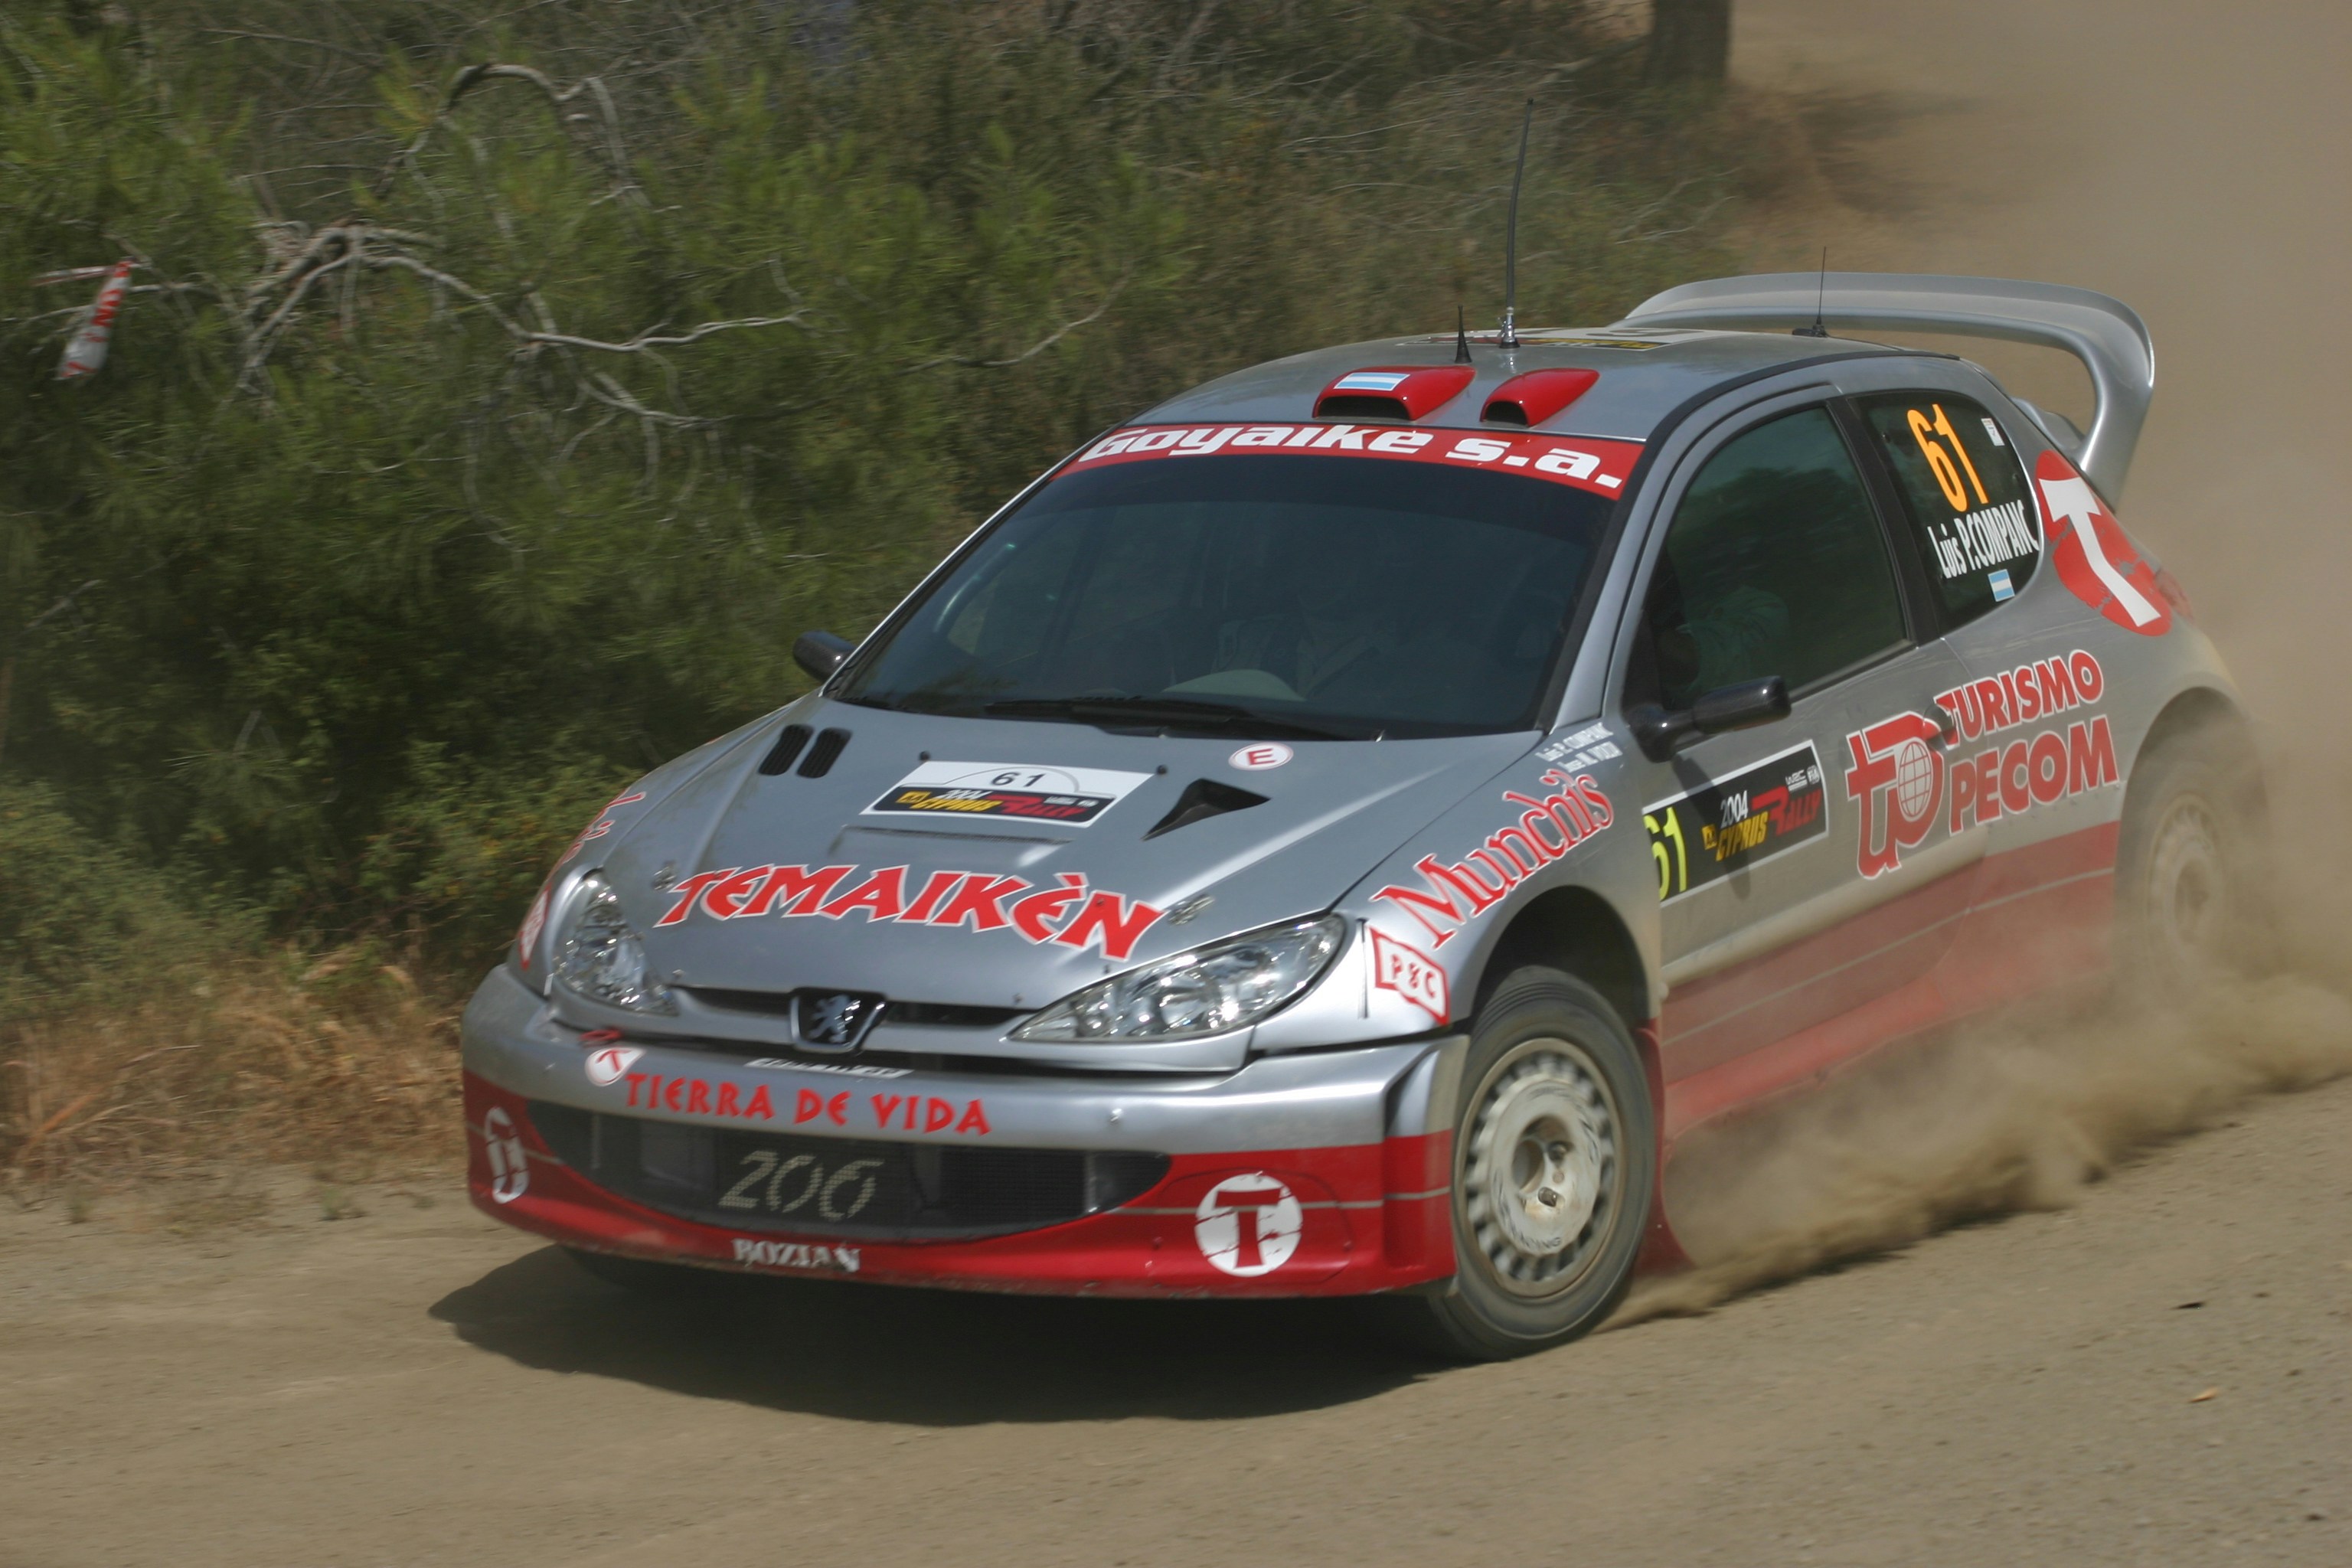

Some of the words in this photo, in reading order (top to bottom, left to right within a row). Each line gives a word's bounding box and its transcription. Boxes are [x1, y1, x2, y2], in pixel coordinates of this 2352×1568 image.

[1079, 425, 1433, 463] Goyaike
[1446, 436, 1622, 488] s.a.
[1907, 403, 1989, 512] 61
[1927, 524, 1968, 580] Luis
[1954, 499, 2040, 571] P.COMPANC
[1933, 648, 2104, 751] TURISMO
[991, 772, 1047, 788] 61
[1246, 748, 1277, 766] E
[1949, 714, 2119, 838] PECOM
[1715, 811, 1769, 861] CYPRUS
[1751, 786, 1822, 837] RALLY
[1720, 790, 1749, 828] 2004
[625, 1073, 773, 1120] TIERRA
[793, 1089, 851, 1125] DE
[871, 1093, 992, 1136] VIDA
[718, 1150, 884, 1223] 206
